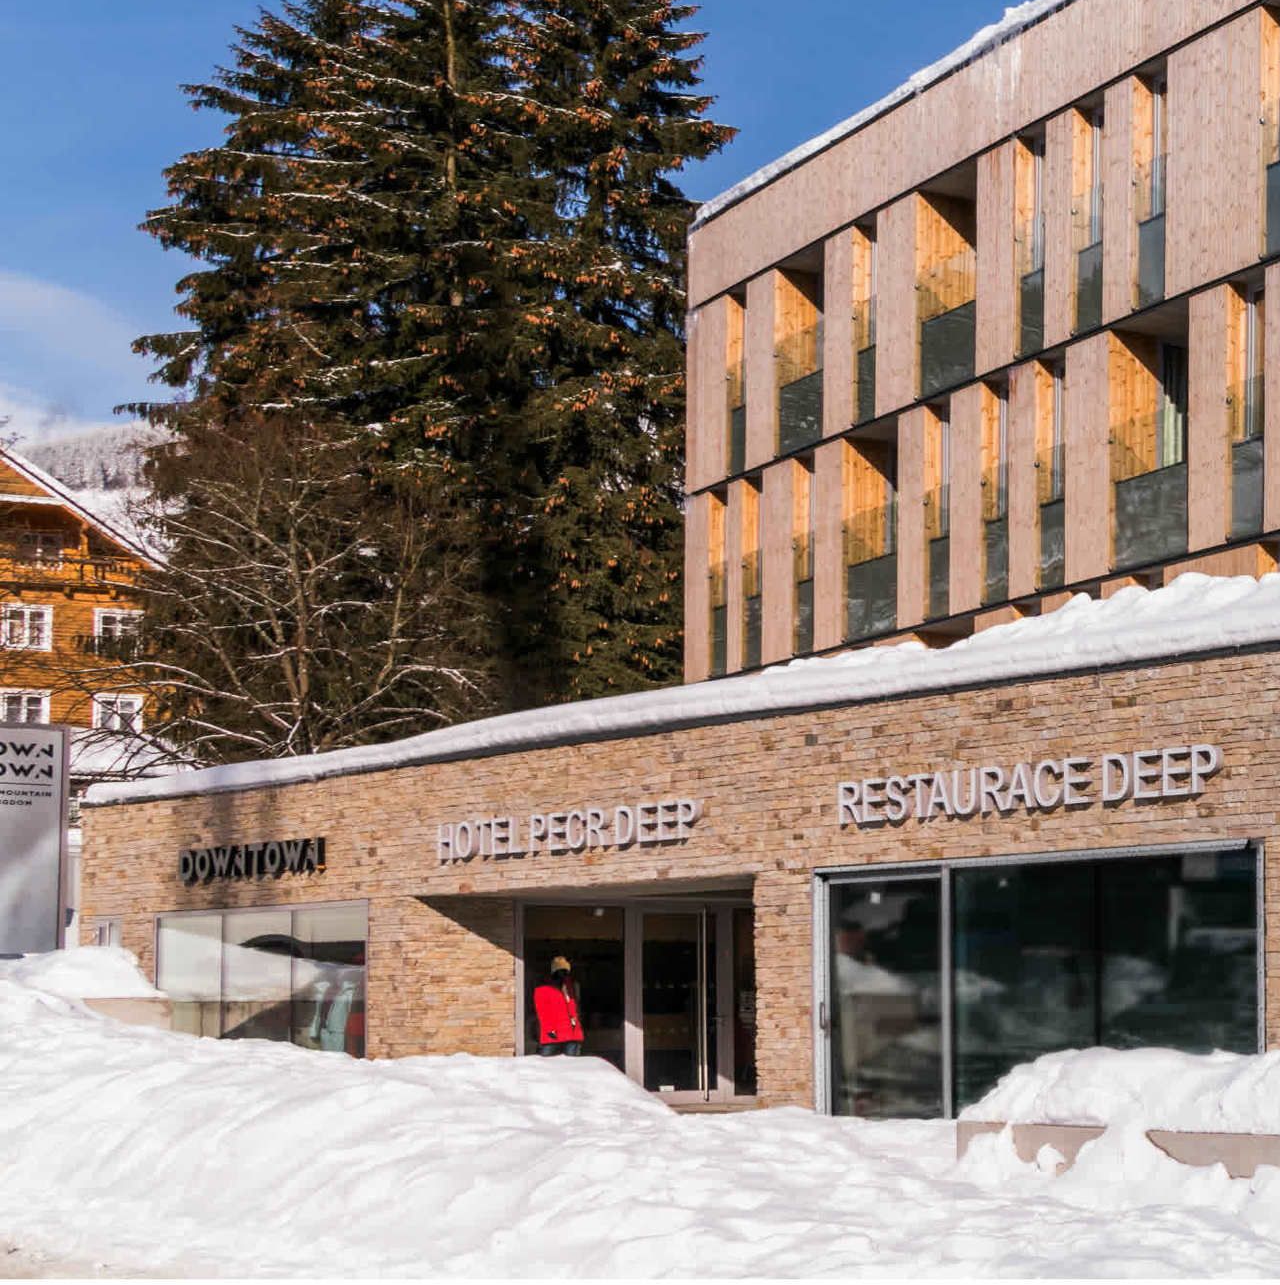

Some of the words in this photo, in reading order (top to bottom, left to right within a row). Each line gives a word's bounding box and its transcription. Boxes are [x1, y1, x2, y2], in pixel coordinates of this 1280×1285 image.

[838, 757, 1094, 825] RESTAURACE
[1102, 744, 1222, 802] DEEP
[179, 837, 325, 883] DOWNTOWN
[438, 817, 525, 861] HOTEL
[530, 808, 609, 852] PECR
[615, 799, 699, 845] DEEP
